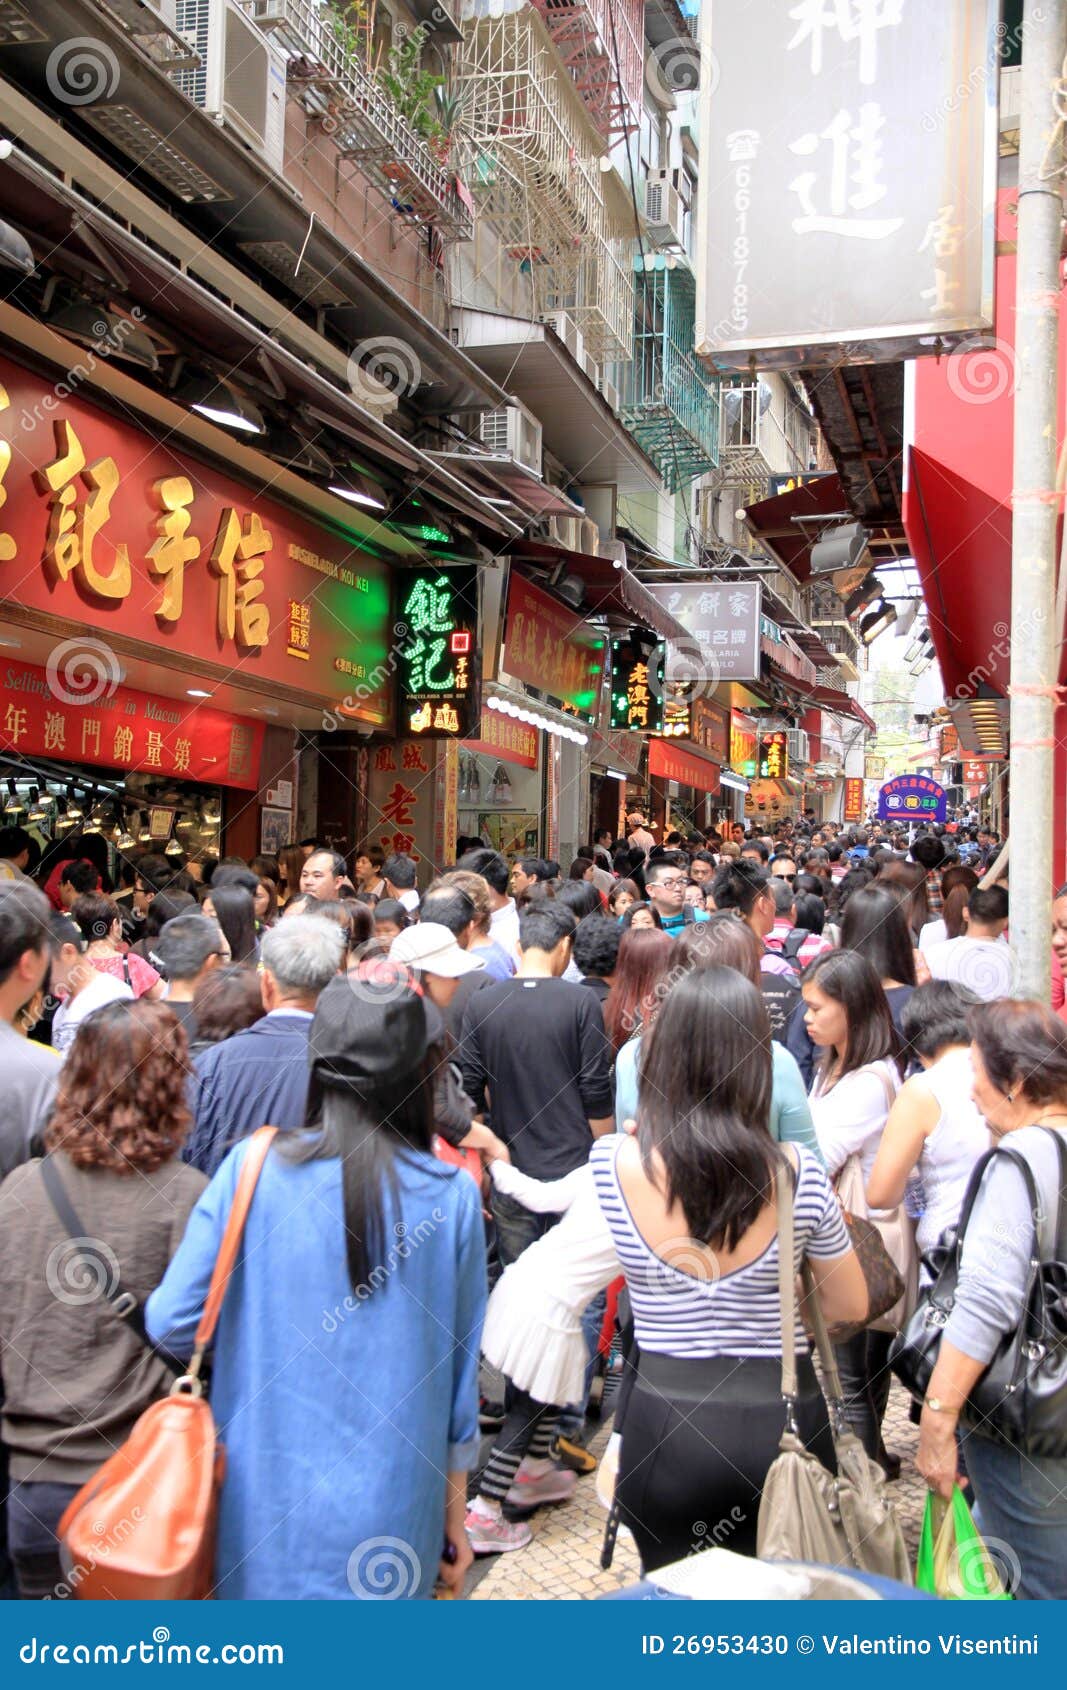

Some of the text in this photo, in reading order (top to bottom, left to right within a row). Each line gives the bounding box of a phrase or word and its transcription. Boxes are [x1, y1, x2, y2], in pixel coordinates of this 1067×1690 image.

[0, 381, 273, 647] 記手信
[356, 576, 369, 593] KEI
[125, 698, 136, 715] in
[144, 701, 182, 724] Macau
[627, 663, 650, 726] 老澳門
[4, 703, 217, 772] 年澳門銷量第一
